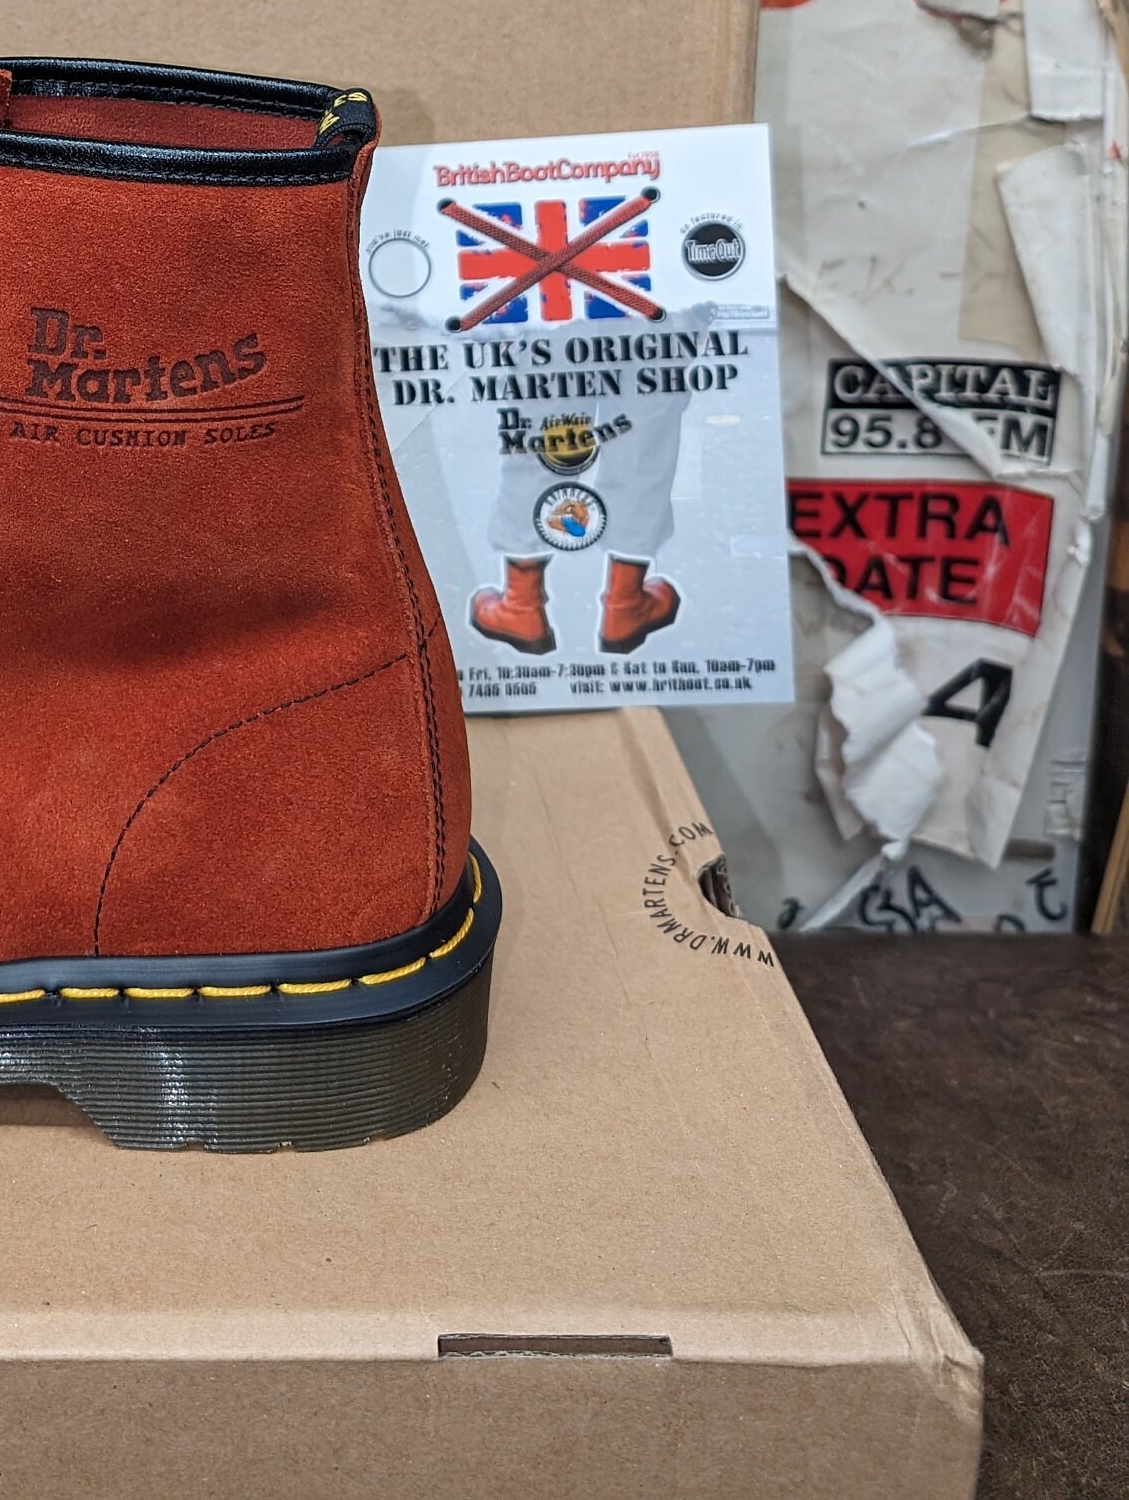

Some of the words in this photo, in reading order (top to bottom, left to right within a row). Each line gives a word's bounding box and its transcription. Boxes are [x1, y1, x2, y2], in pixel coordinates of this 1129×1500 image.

[434, 156, 660, 187] BritishBootCompany
[27, 307, 107, 360] Dr.
[373, 344, 449, 373] THE
[463, 338, 551, 370] UK'S
[565, 330, 748, 364] ORIGINAL
[25, 333, 267, 404] Martens
[394, 378, 455, 406] DR.
[470, 369, 622, 401] MARTEN
[636, 364, 738, 395] SHOP
[833, 363, 1055, 407] CAPITAL
[10, 421, 60, 442] AIR
[76, 428, 188, 447] CUSHION
[205, 422, 276, 445] SOLES
[498, 414, 632, 455] Martens
[830, 414, 943, 449] 95.8
[789, 489, 1011, 547] EXTRA
[706, 658, 776, 673] 10am-7pm
[642, 821, 775, 968] WWW.DRMARTENS.COM
